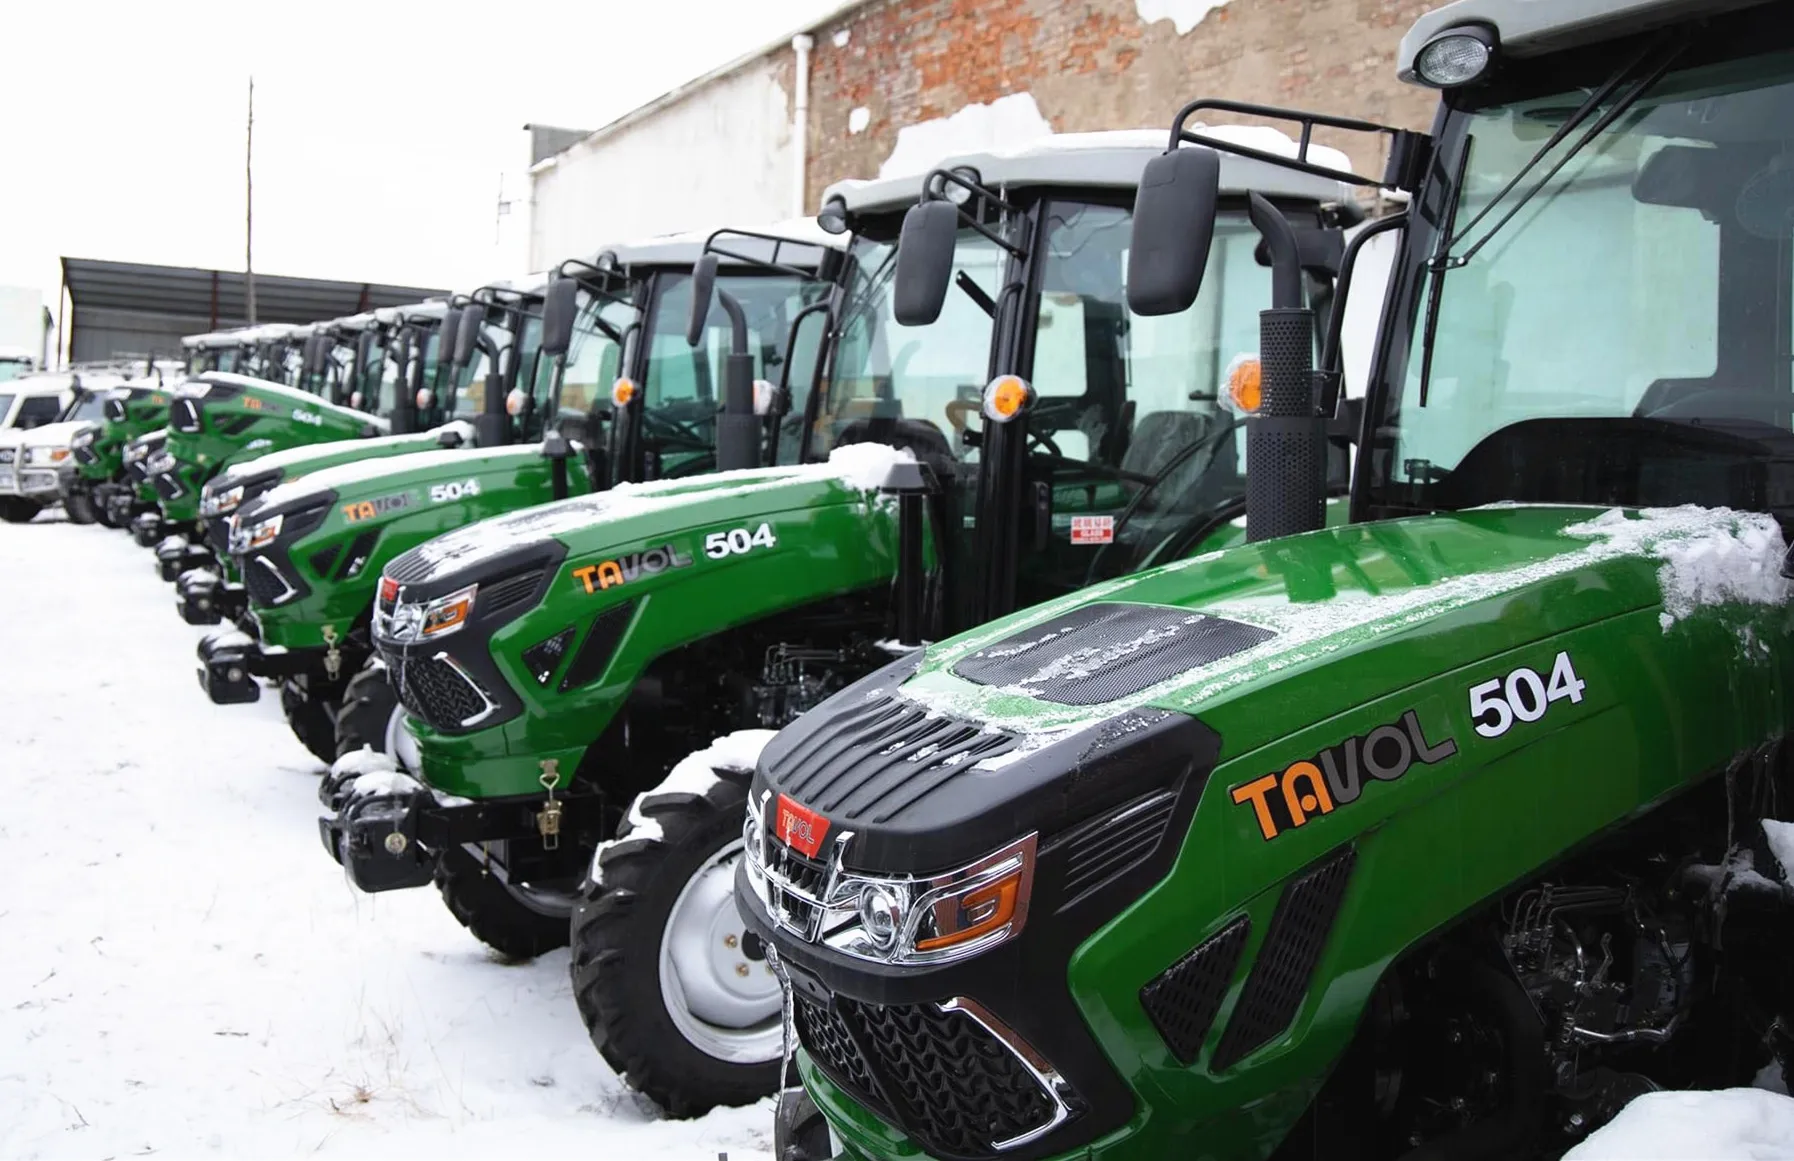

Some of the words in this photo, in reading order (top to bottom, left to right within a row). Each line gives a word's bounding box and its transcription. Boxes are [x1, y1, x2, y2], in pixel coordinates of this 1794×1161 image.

[431, 479, 479, 503] 504
[572, 544, 693, 595] TAVOL
[705, 523, 776, 560] 504
[1230, 709, 1457, 841] TAVOL
[1469, 651, 1585, 737] 504
[782, 808, 815, 845] TAVOL
